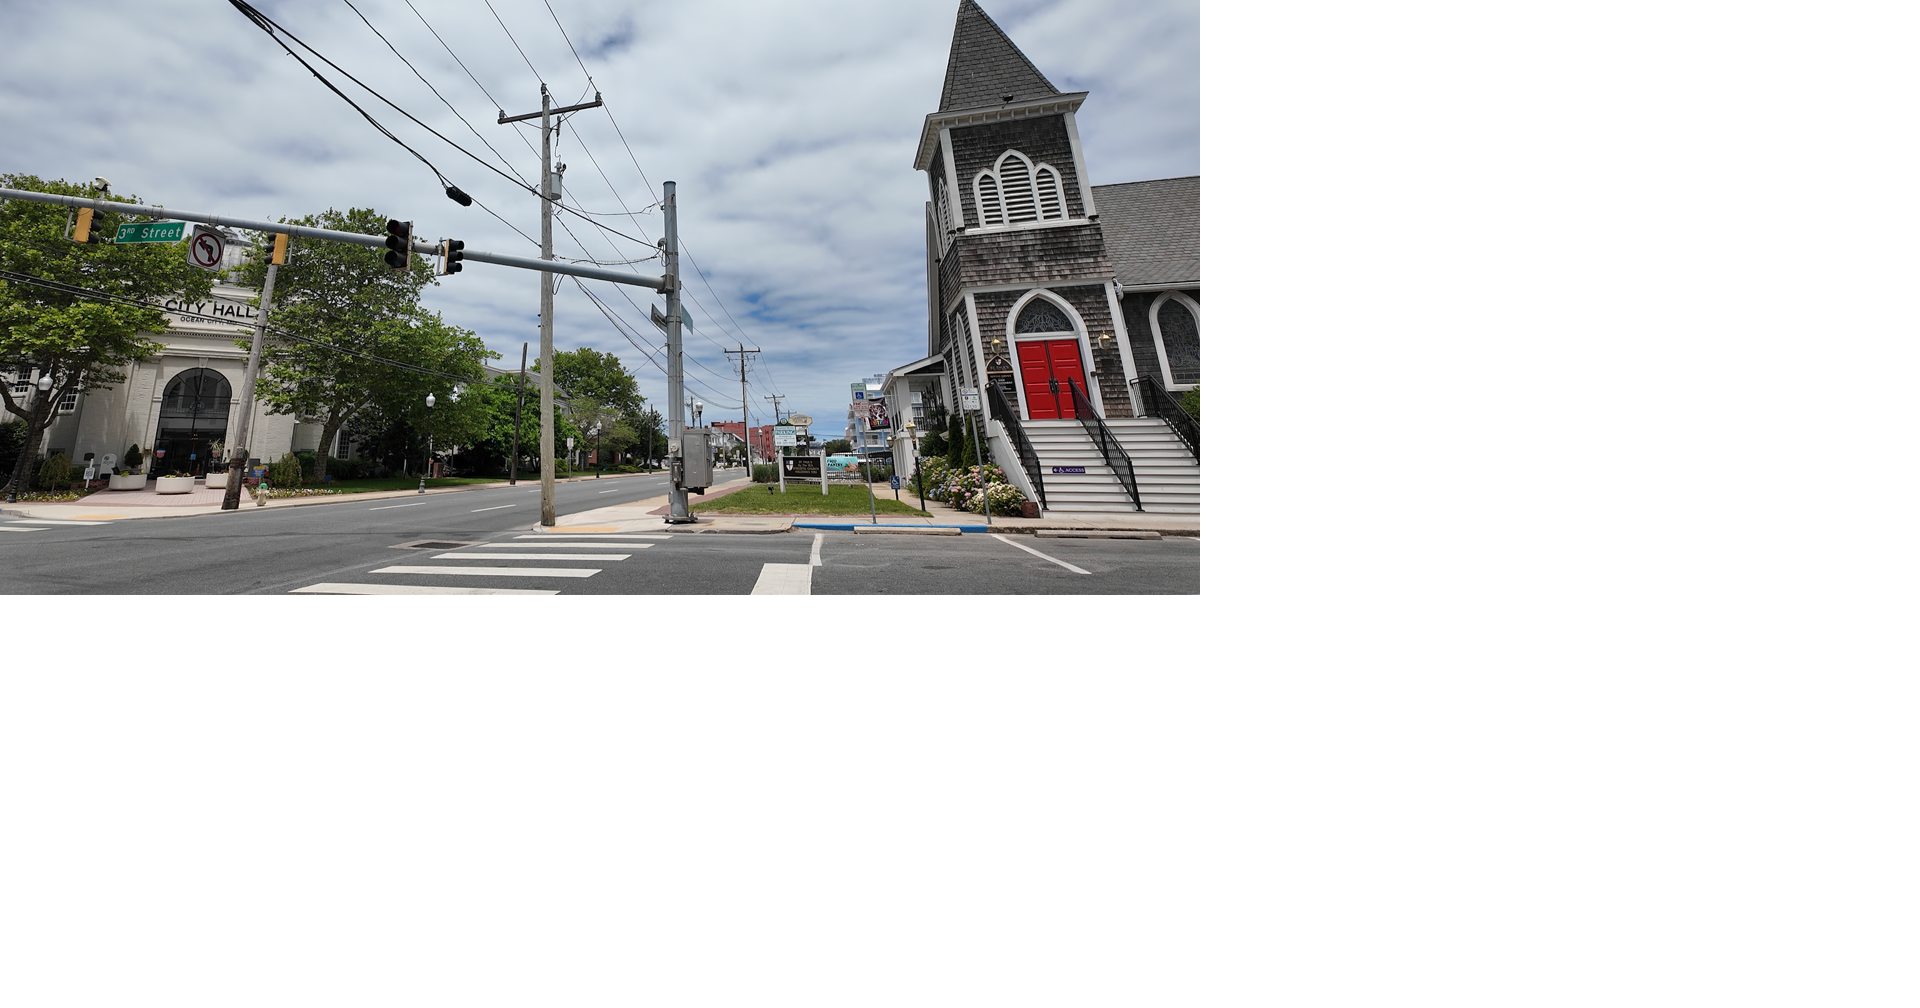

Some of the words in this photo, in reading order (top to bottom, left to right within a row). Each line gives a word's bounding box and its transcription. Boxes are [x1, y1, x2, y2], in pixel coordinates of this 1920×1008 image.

[118, 227, 136, 240] 3RD
[141, 226, 182, 239] Street
[164, 299, 207, 314] CITY
[212, 302, 256, 319] HALL
